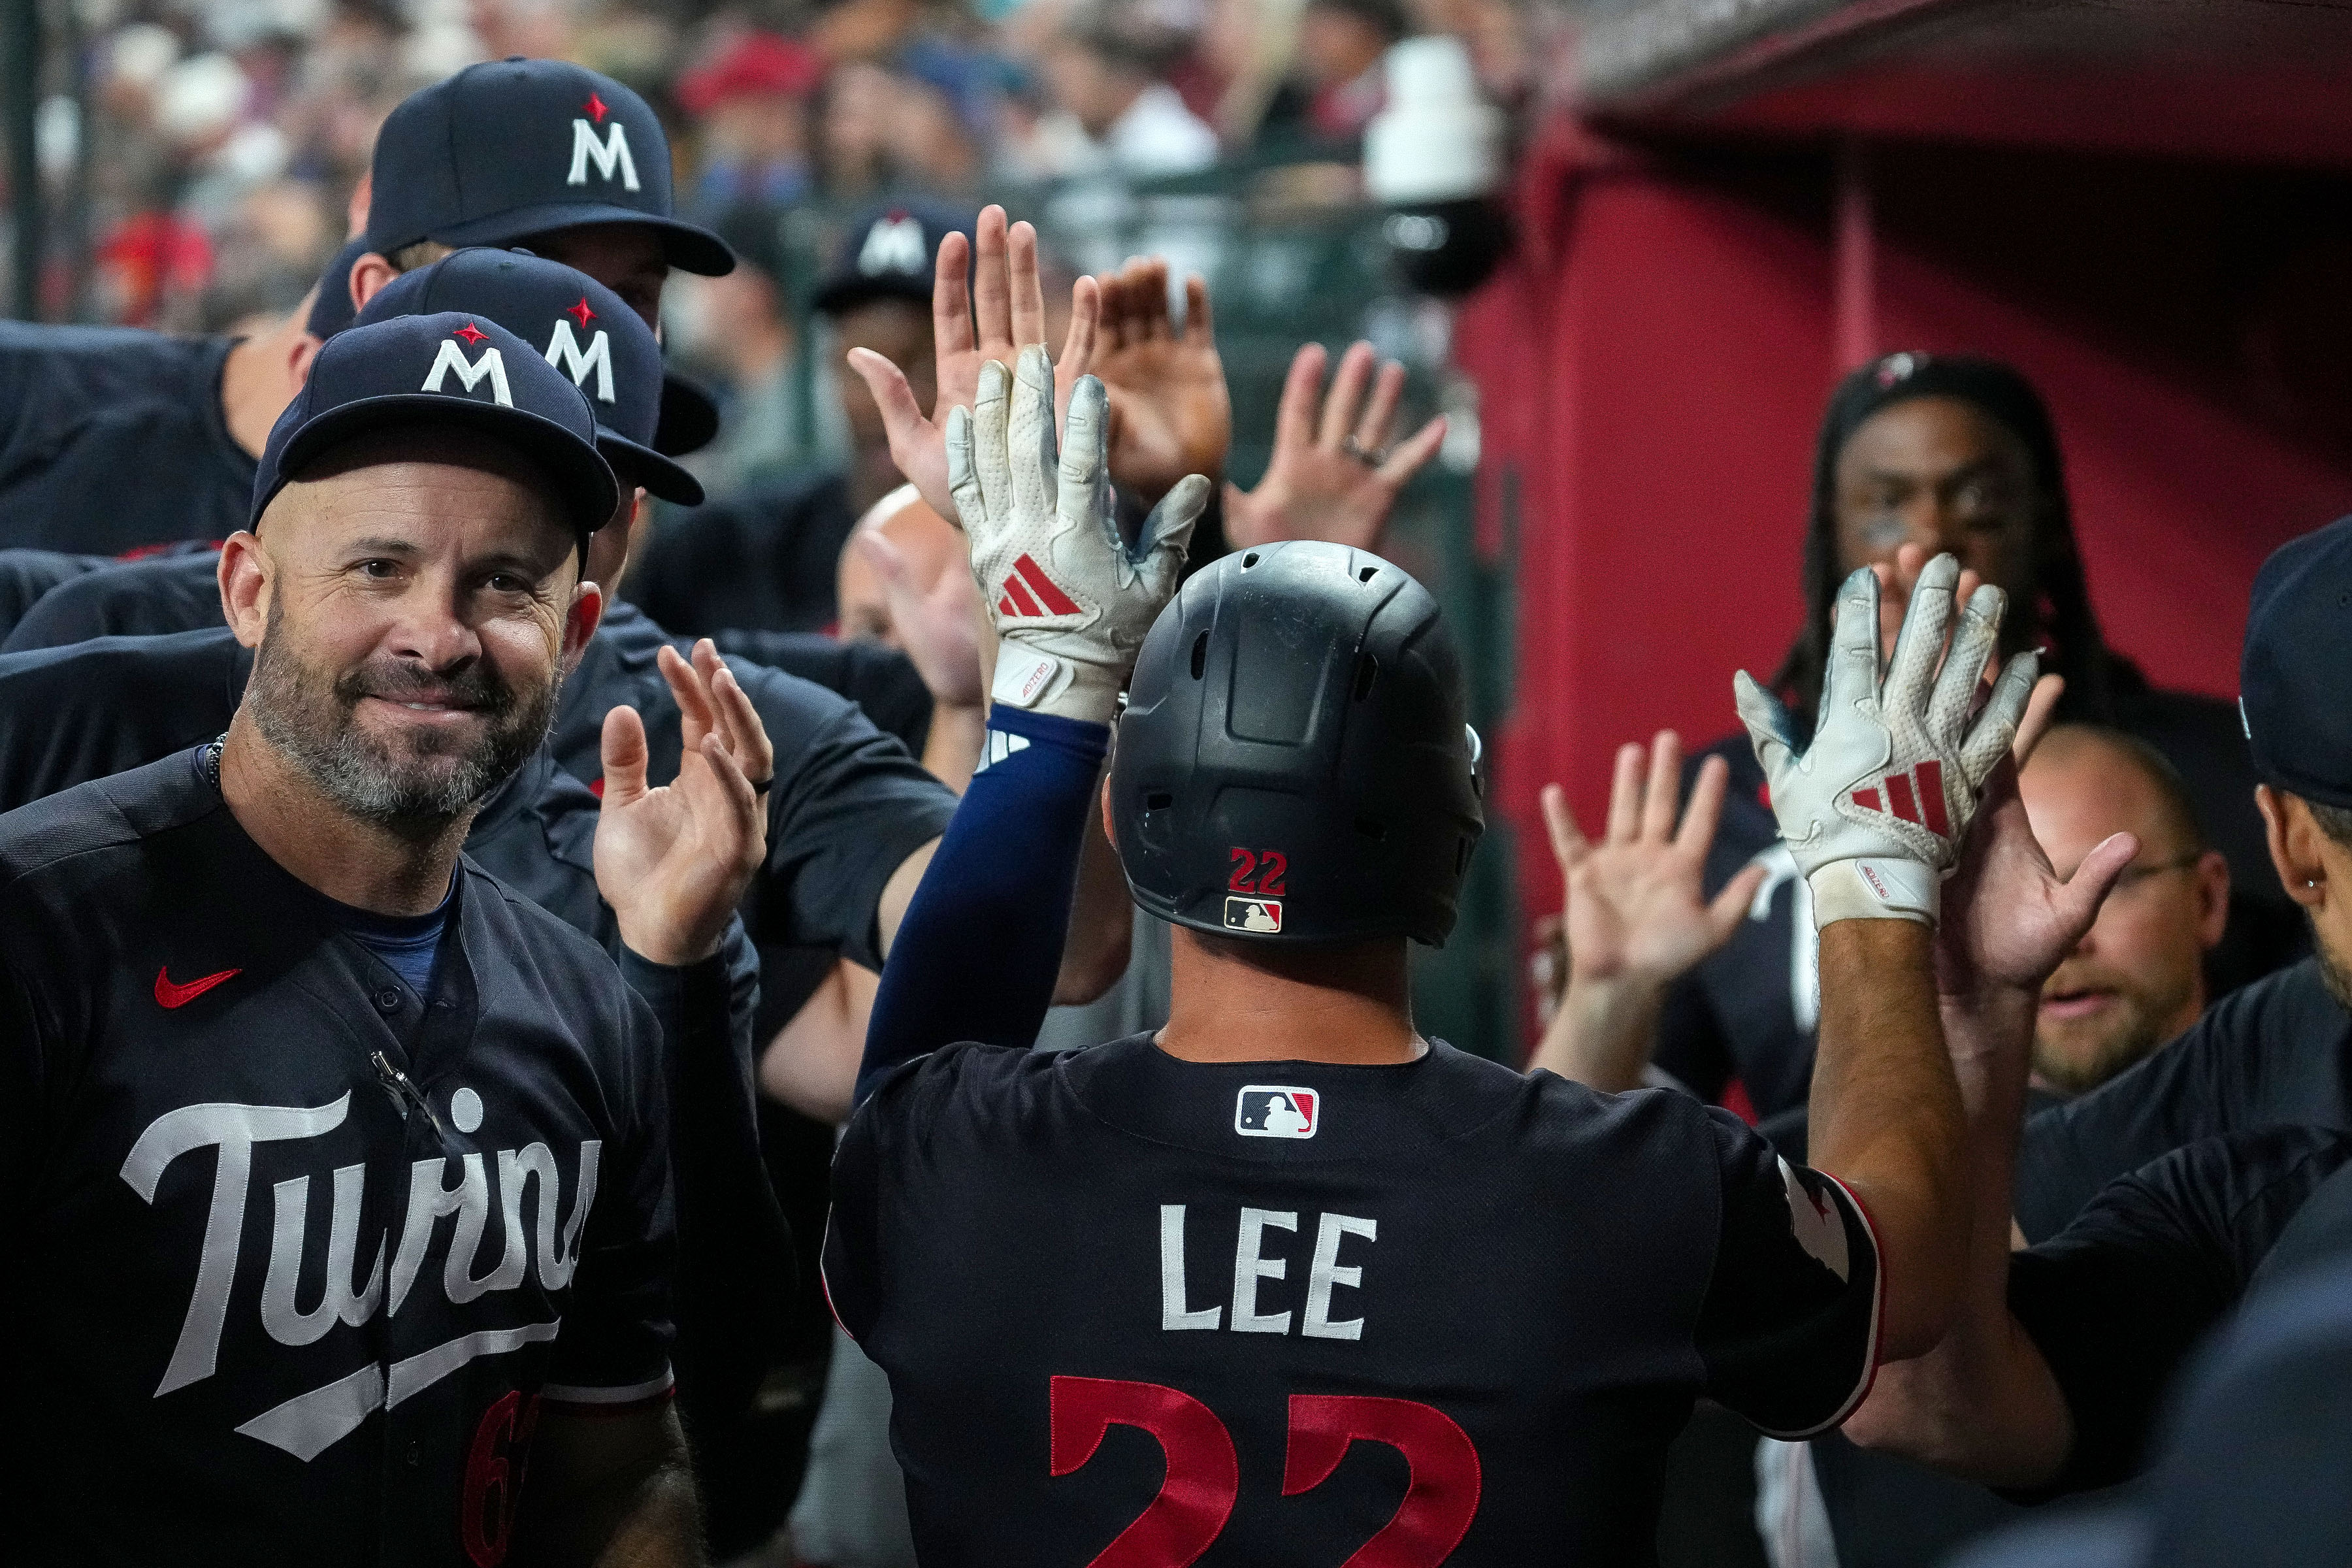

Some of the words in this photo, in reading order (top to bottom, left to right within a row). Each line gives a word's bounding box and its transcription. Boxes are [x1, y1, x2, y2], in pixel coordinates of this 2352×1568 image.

[567, 118, 640, 191] M
[421, 339, 514, 408] M
[545, 319, 615, 404] M
[1022, 661, 1049, 698] ADIZERO
[1228, 847, 1288, 896] 22
[1160, 1204, 1377, 1341] LEE
[1050, 1375, 1482, 1568] 22
